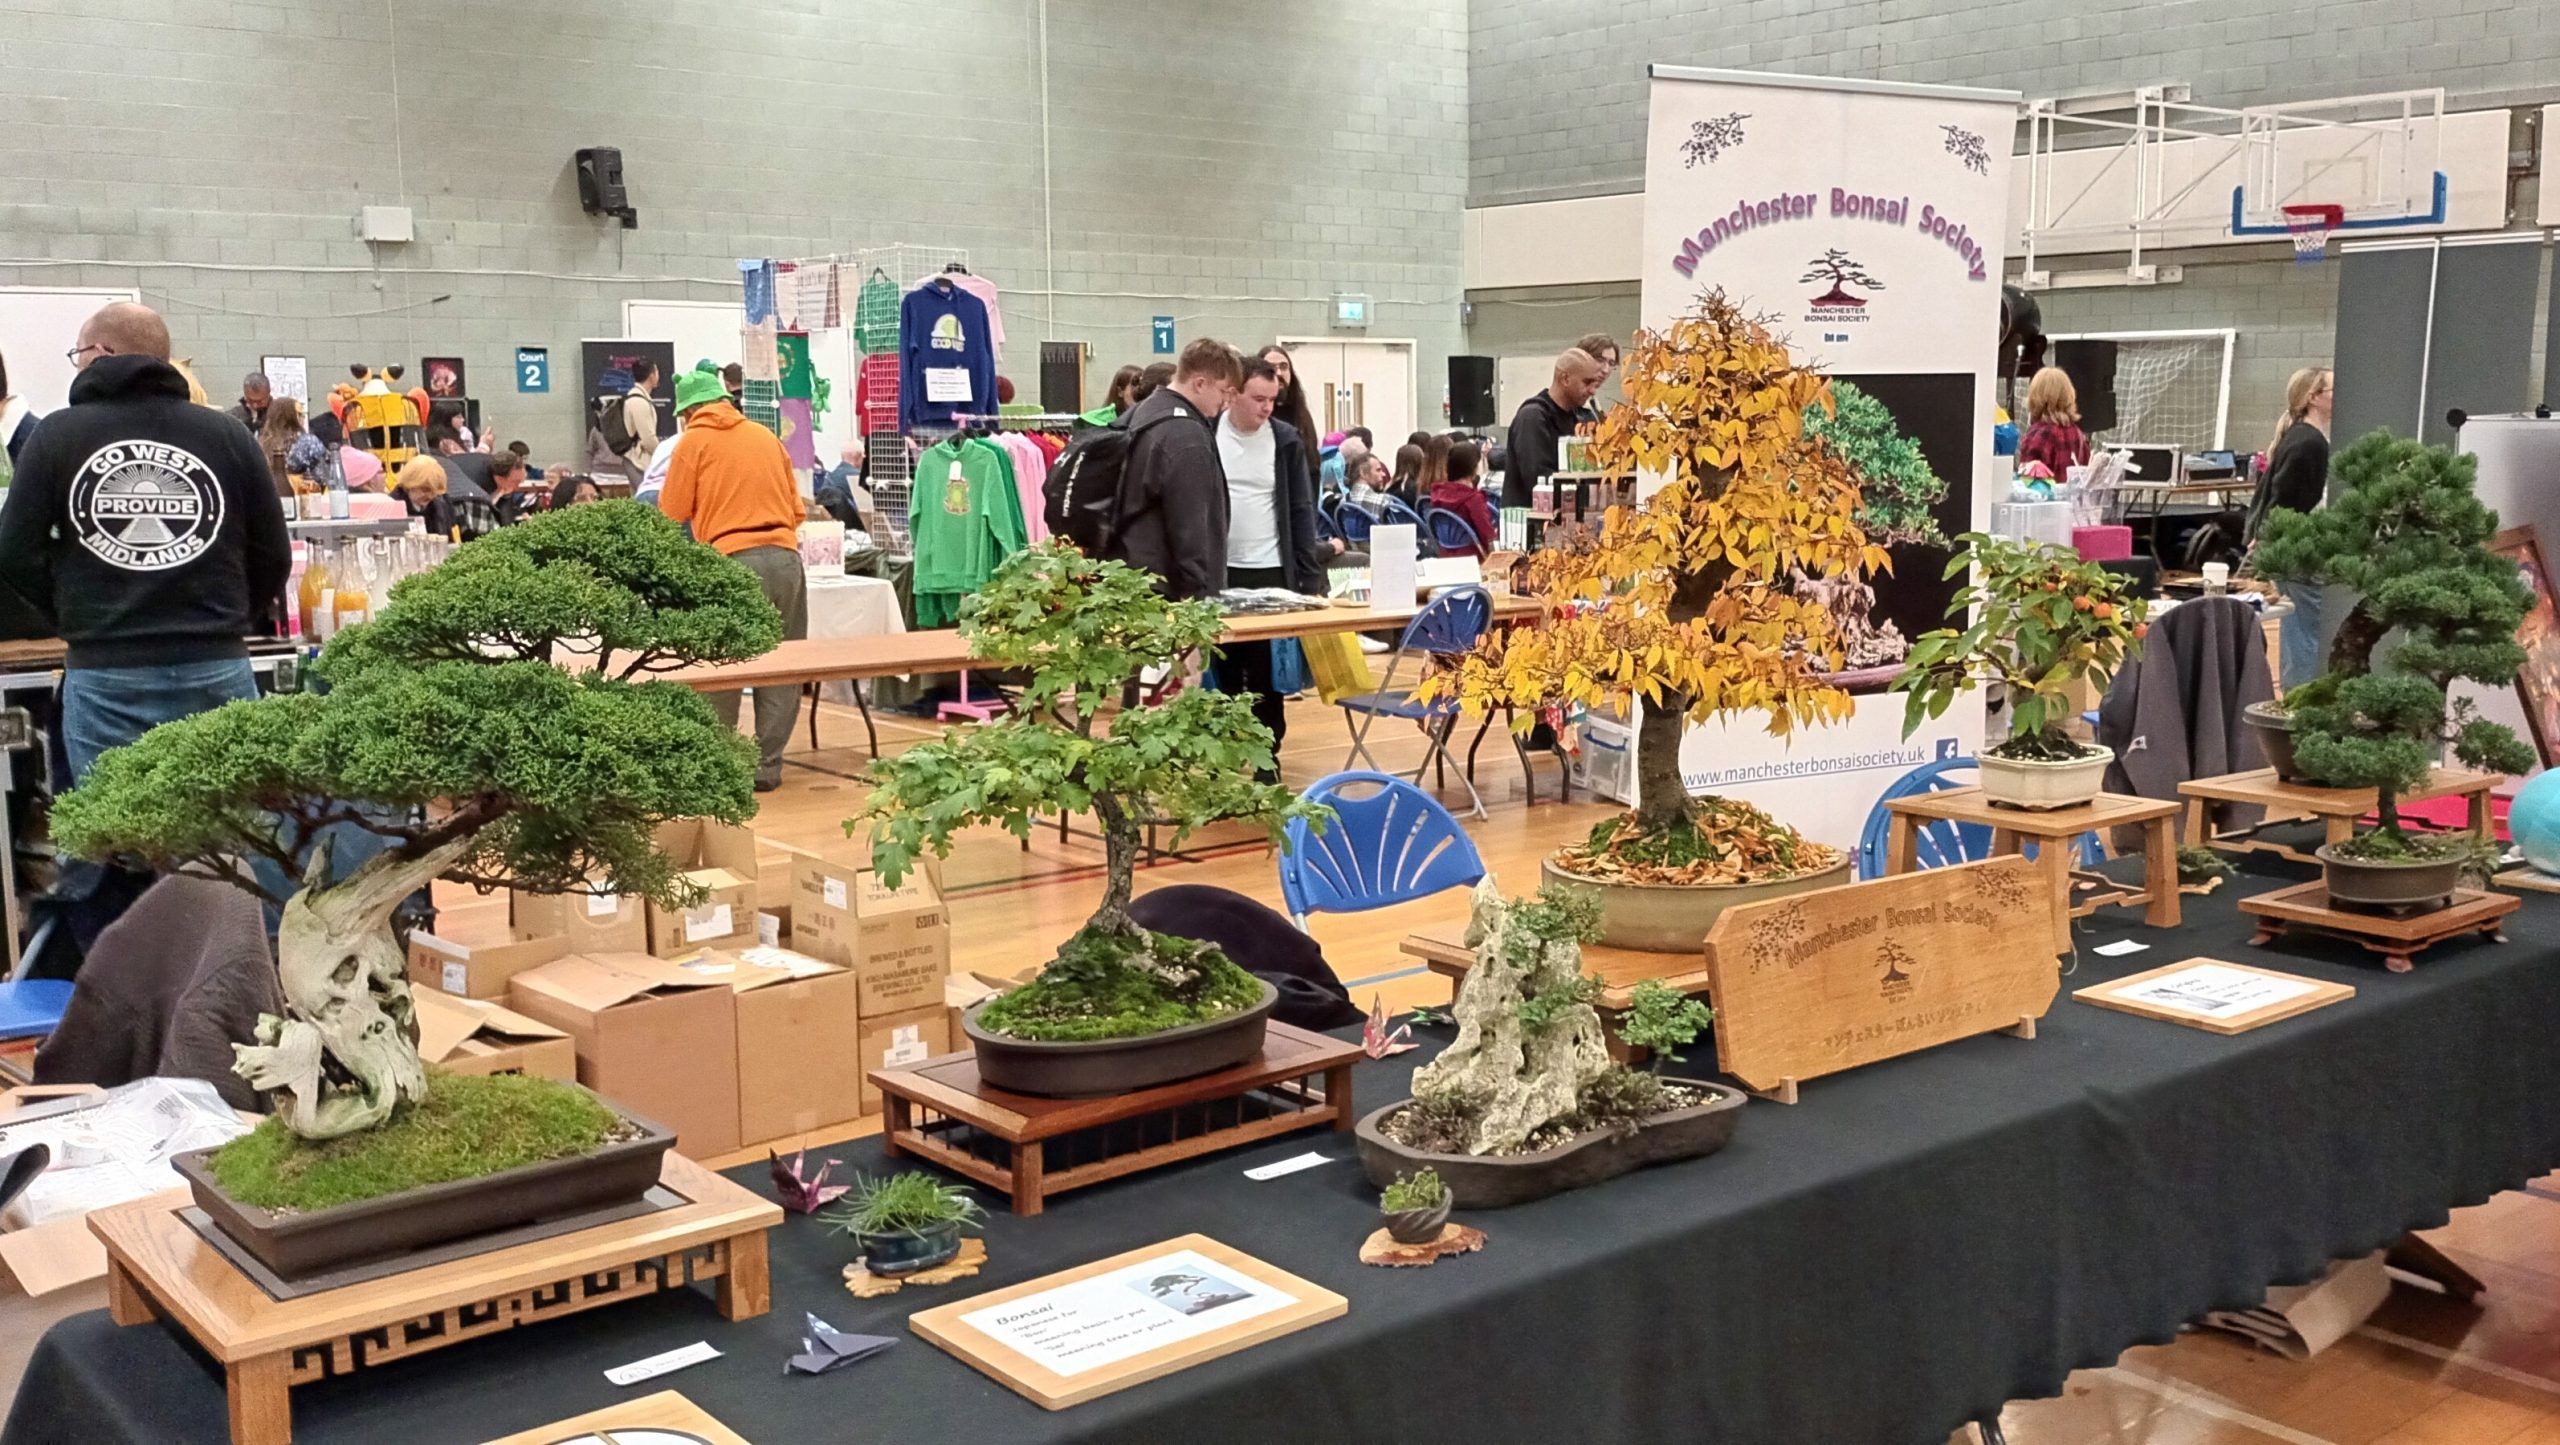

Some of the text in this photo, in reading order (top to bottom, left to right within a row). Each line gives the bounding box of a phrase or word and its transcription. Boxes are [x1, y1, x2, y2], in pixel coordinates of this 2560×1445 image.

[1673, 187, 1987, 281] Manchester Bonsai Society
[1159, 331, 1167, 348] 1
[518, 352, 544, 363] Court
[525, 365, 541, 386] 2
[91, 445, 201, 475] GO WEST
[97, 499, 195, 513] PROVIDE
[86, 533, 205, 566] MIDLANDS
[1684, 746, 1925, 786] www.manchesterbonsaisociety.uk
[1784, 902, 1998, 969] Manchester Bonsai Society
[996, 1303, 1053, 1325] Bonsai
[1012, 1316, 1058, 1332] Japanese
[1034, 1329, 1081, 1345] meaning
[1082, 1319, 1111, 1330] basin
[1128, 1308, 1146, 1317] pot
[1057, 1342, 1105, 1358] meaning
[1106, 1333, 1129, 1343] tree
[1147, 1318, 1174, 1331] plant
